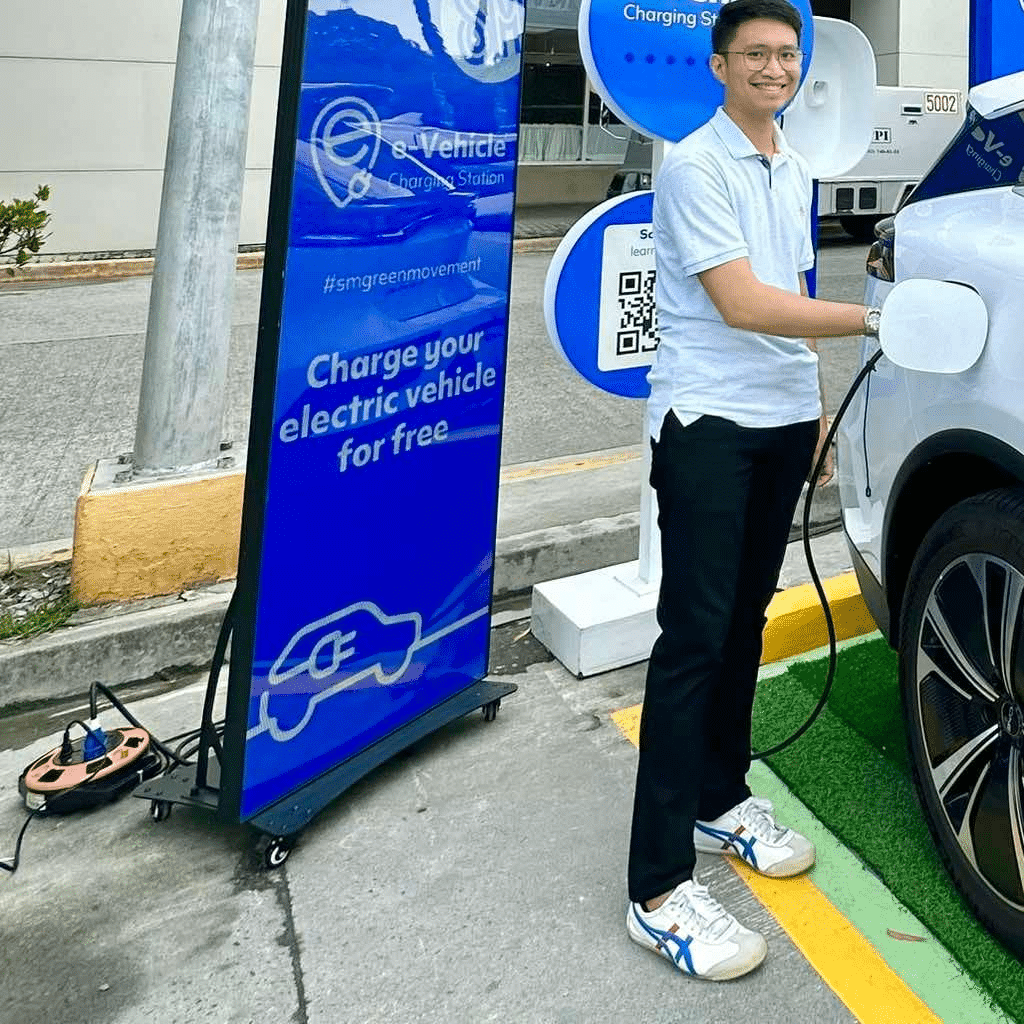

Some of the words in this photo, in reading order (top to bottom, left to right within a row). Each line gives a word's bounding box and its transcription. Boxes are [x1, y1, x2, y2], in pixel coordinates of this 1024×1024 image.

[623, 3, 697, 29] Charging
[926, 94, 957, 113] 5002
[391, 132, 507, 160] e-Vehicle
[458, 169, 505, 187] Station
[323, 256, 482, 294] #smgreenmovement
[306, 344, 418, 389] Charge
[424, 330, 484, 370] your
[279, 386, 400, 444] electric
[405, 361, 497, 408] vehicle
[337, 438, 386, 474] for
[391, 419, 449, 455] free
